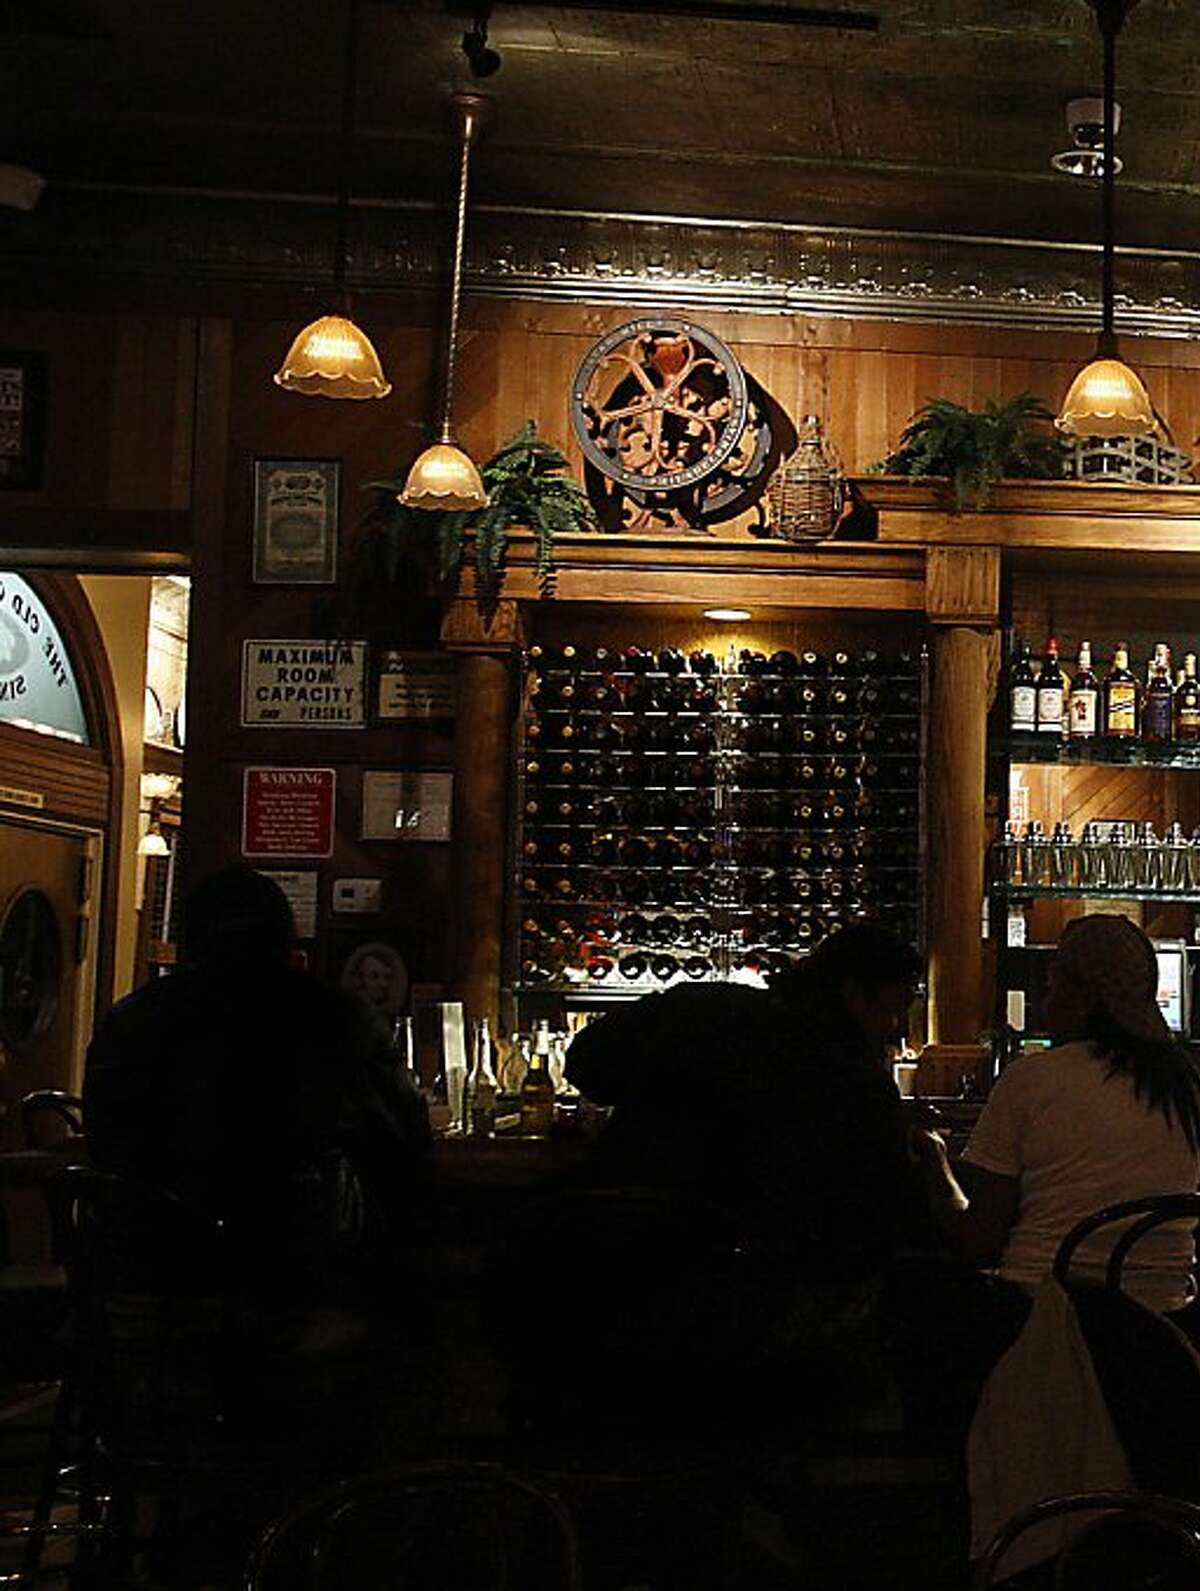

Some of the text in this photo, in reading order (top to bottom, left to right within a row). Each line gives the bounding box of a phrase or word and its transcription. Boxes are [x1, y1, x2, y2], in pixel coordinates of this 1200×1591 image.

[258, 648, 355, 665] MAXIMUM
[277, 667, 335, 683] ROOM
[256, 686, 354, 703] CAPACITY
[259, 771, 323, 785] WARNING
